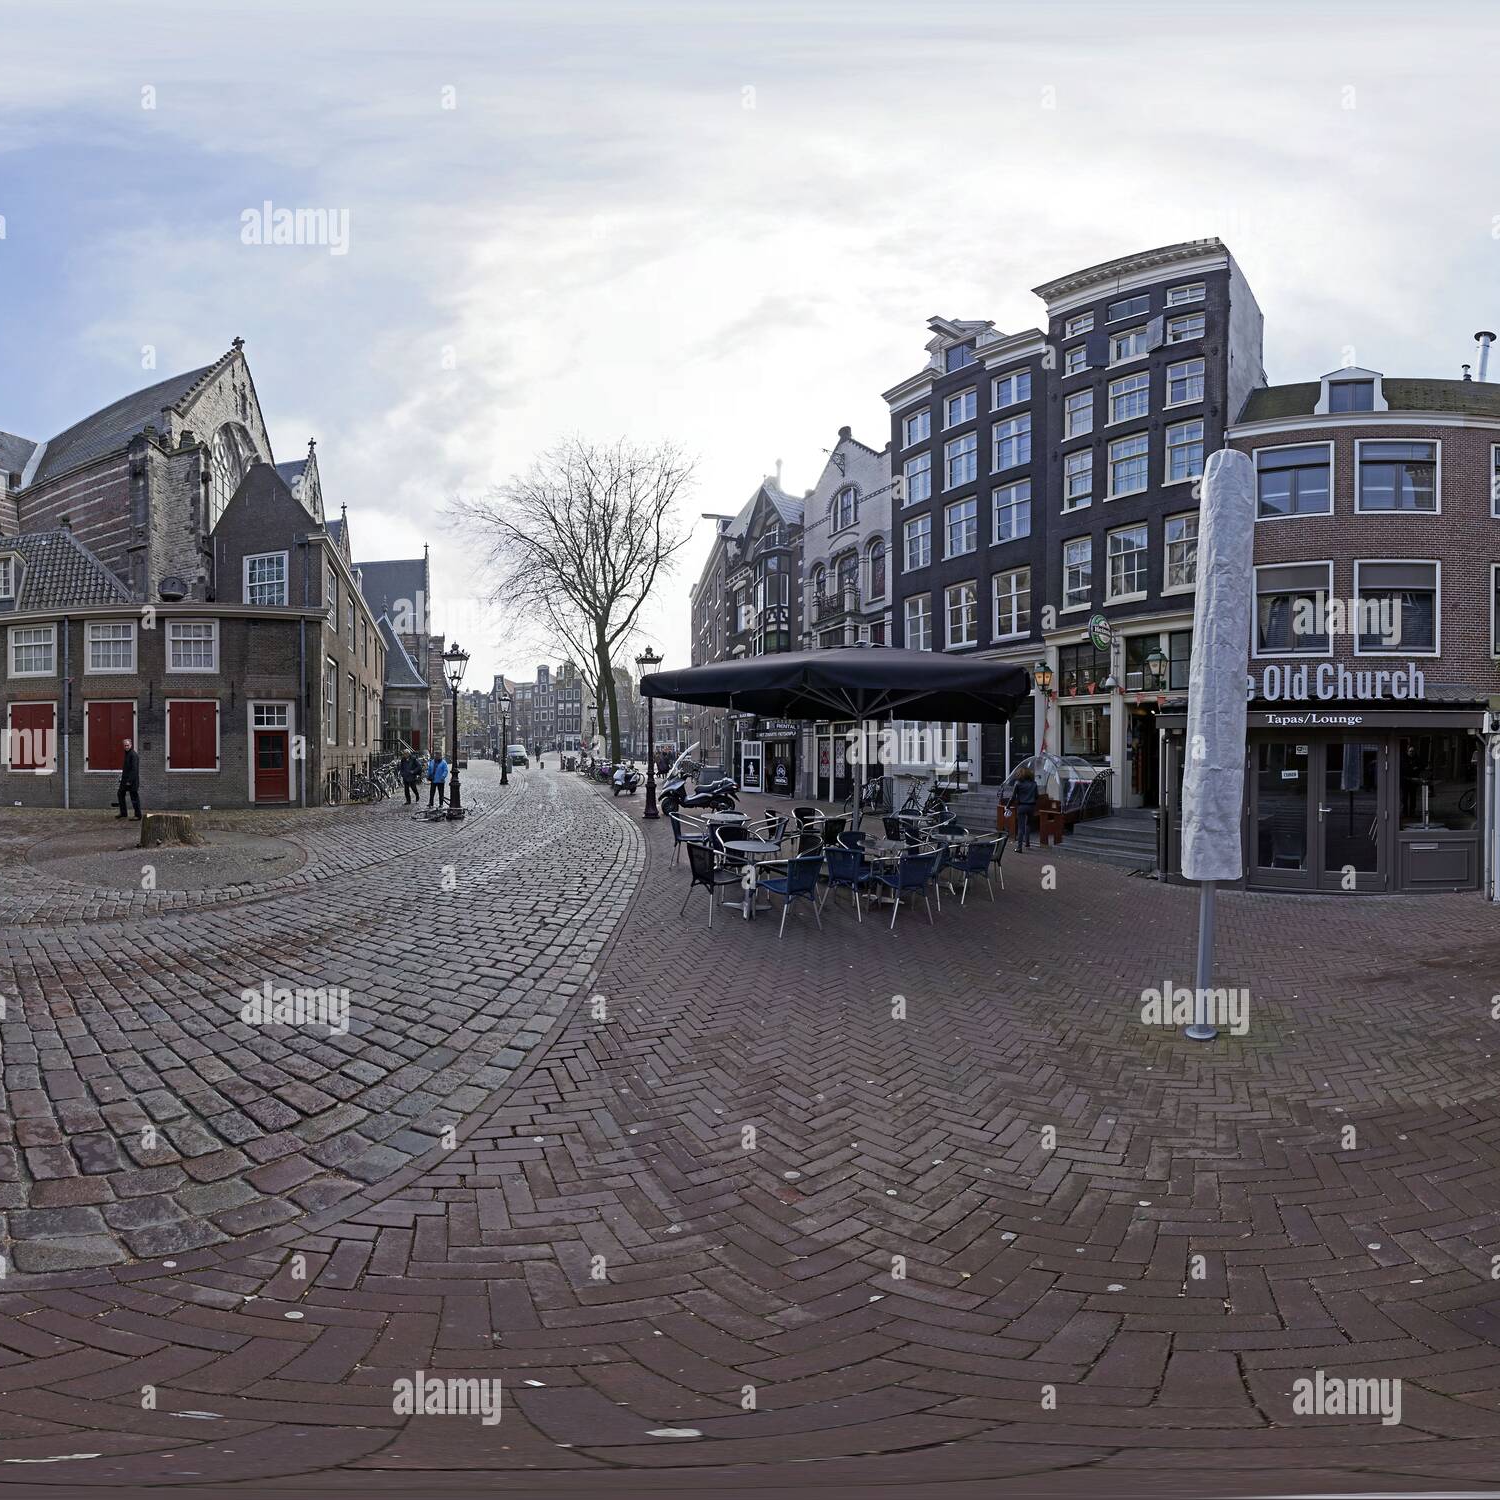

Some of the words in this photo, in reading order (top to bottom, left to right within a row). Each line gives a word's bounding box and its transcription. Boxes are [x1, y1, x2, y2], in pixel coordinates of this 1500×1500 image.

[1263, 664, 1308, 701] Old
[1316, 662, 1425, 701] Church
[1265, 713, 1363, 726] Tapas/Lounge
